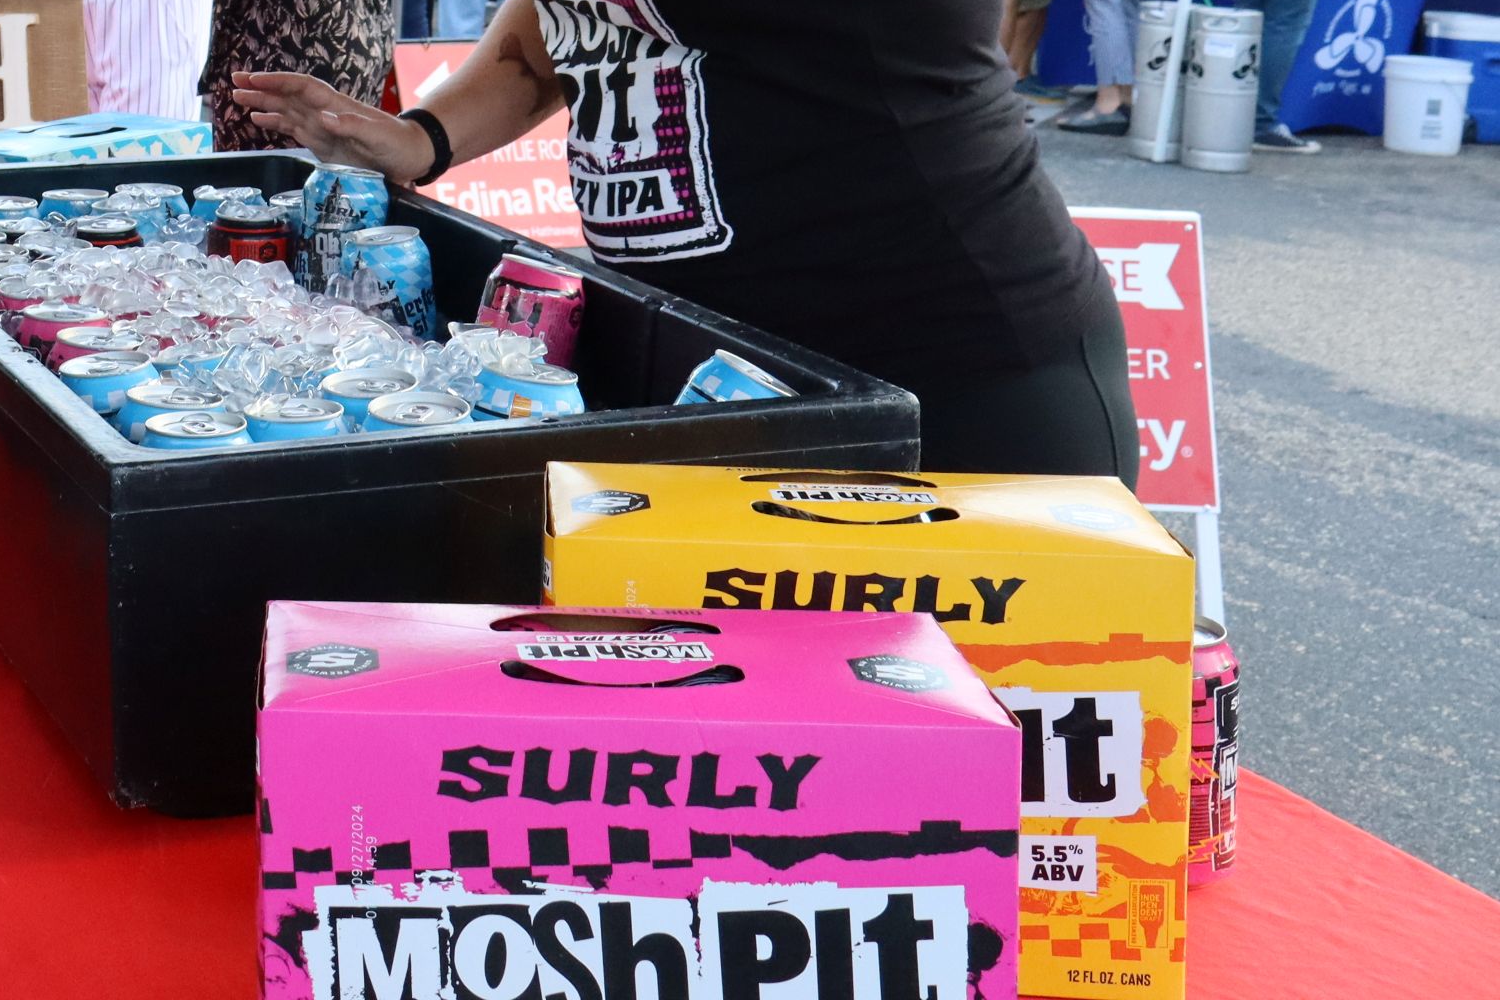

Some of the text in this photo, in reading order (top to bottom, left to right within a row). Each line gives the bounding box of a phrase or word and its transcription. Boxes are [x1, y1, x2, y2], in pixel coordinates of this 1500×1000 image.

[435, 176, 580, 217] Edina Re
[607, 174, 664, 217] IPA
[626, 579, 637, 608] 2024
[702, 566, 1027, 625] SURLY
[437, 745, 823, 812] SURLY
[351, 804, 364, 885] 09/27/2024
[1031, 844, 1084, 863] 5.5%
[1031, 864, 1085, 882] ABV
[1067, 970, 1080, 983] 12
[1120, 972, 1151, 987] CANS
